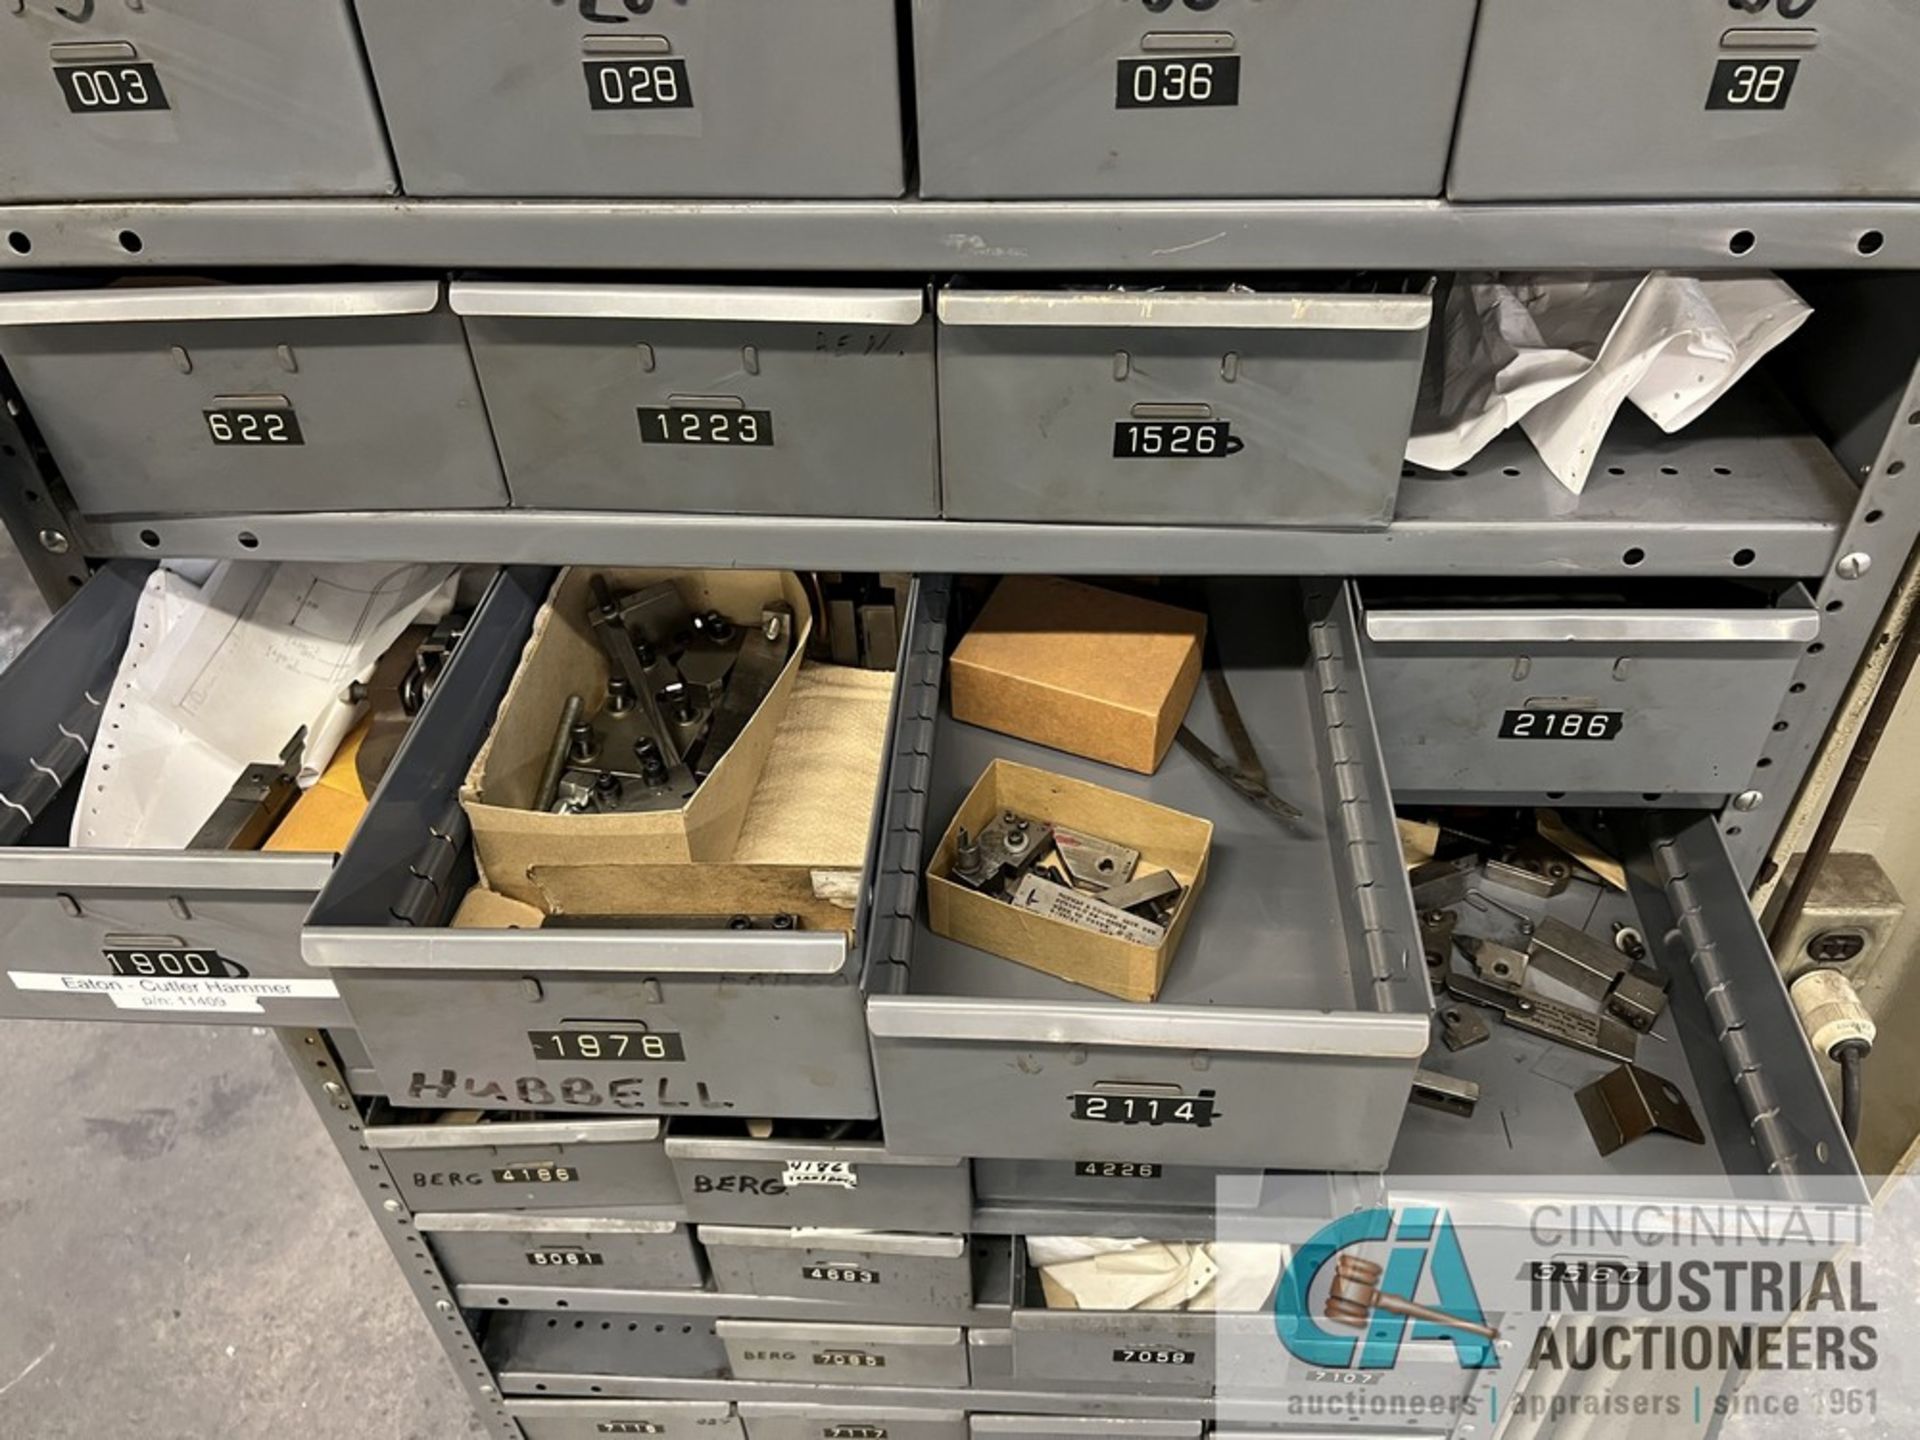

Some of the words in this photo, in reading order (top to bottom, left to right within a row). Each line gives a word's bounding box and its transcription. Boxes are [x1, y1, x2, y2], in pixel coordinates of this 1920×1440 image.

[71, 69, 149, 106] 003
[600, 65, 678, 104] 028
[1133, 62, 1213, 102] 036
[1726, 65, 1785, 104] 38
[208, 413, 288, 441] 622
[657, 413, 758, 442] 1223
[1128, 425, 1217, 454] 1526
[1513, 713, 1609, 737] 2186
[107, 953, 210, 975] 1900
[61, 976, 122, 992] Eaton
[138, 977, 199, 994] Cutler
[205, 979, 292, 995] Hammer
[551, 1034, 666, 1059] 1978
[1085, 1097, 1196, 1122] 2114
[413, 1172, 484, 1188] BERG
[1085, 1162, 1153, 1177] 4226
